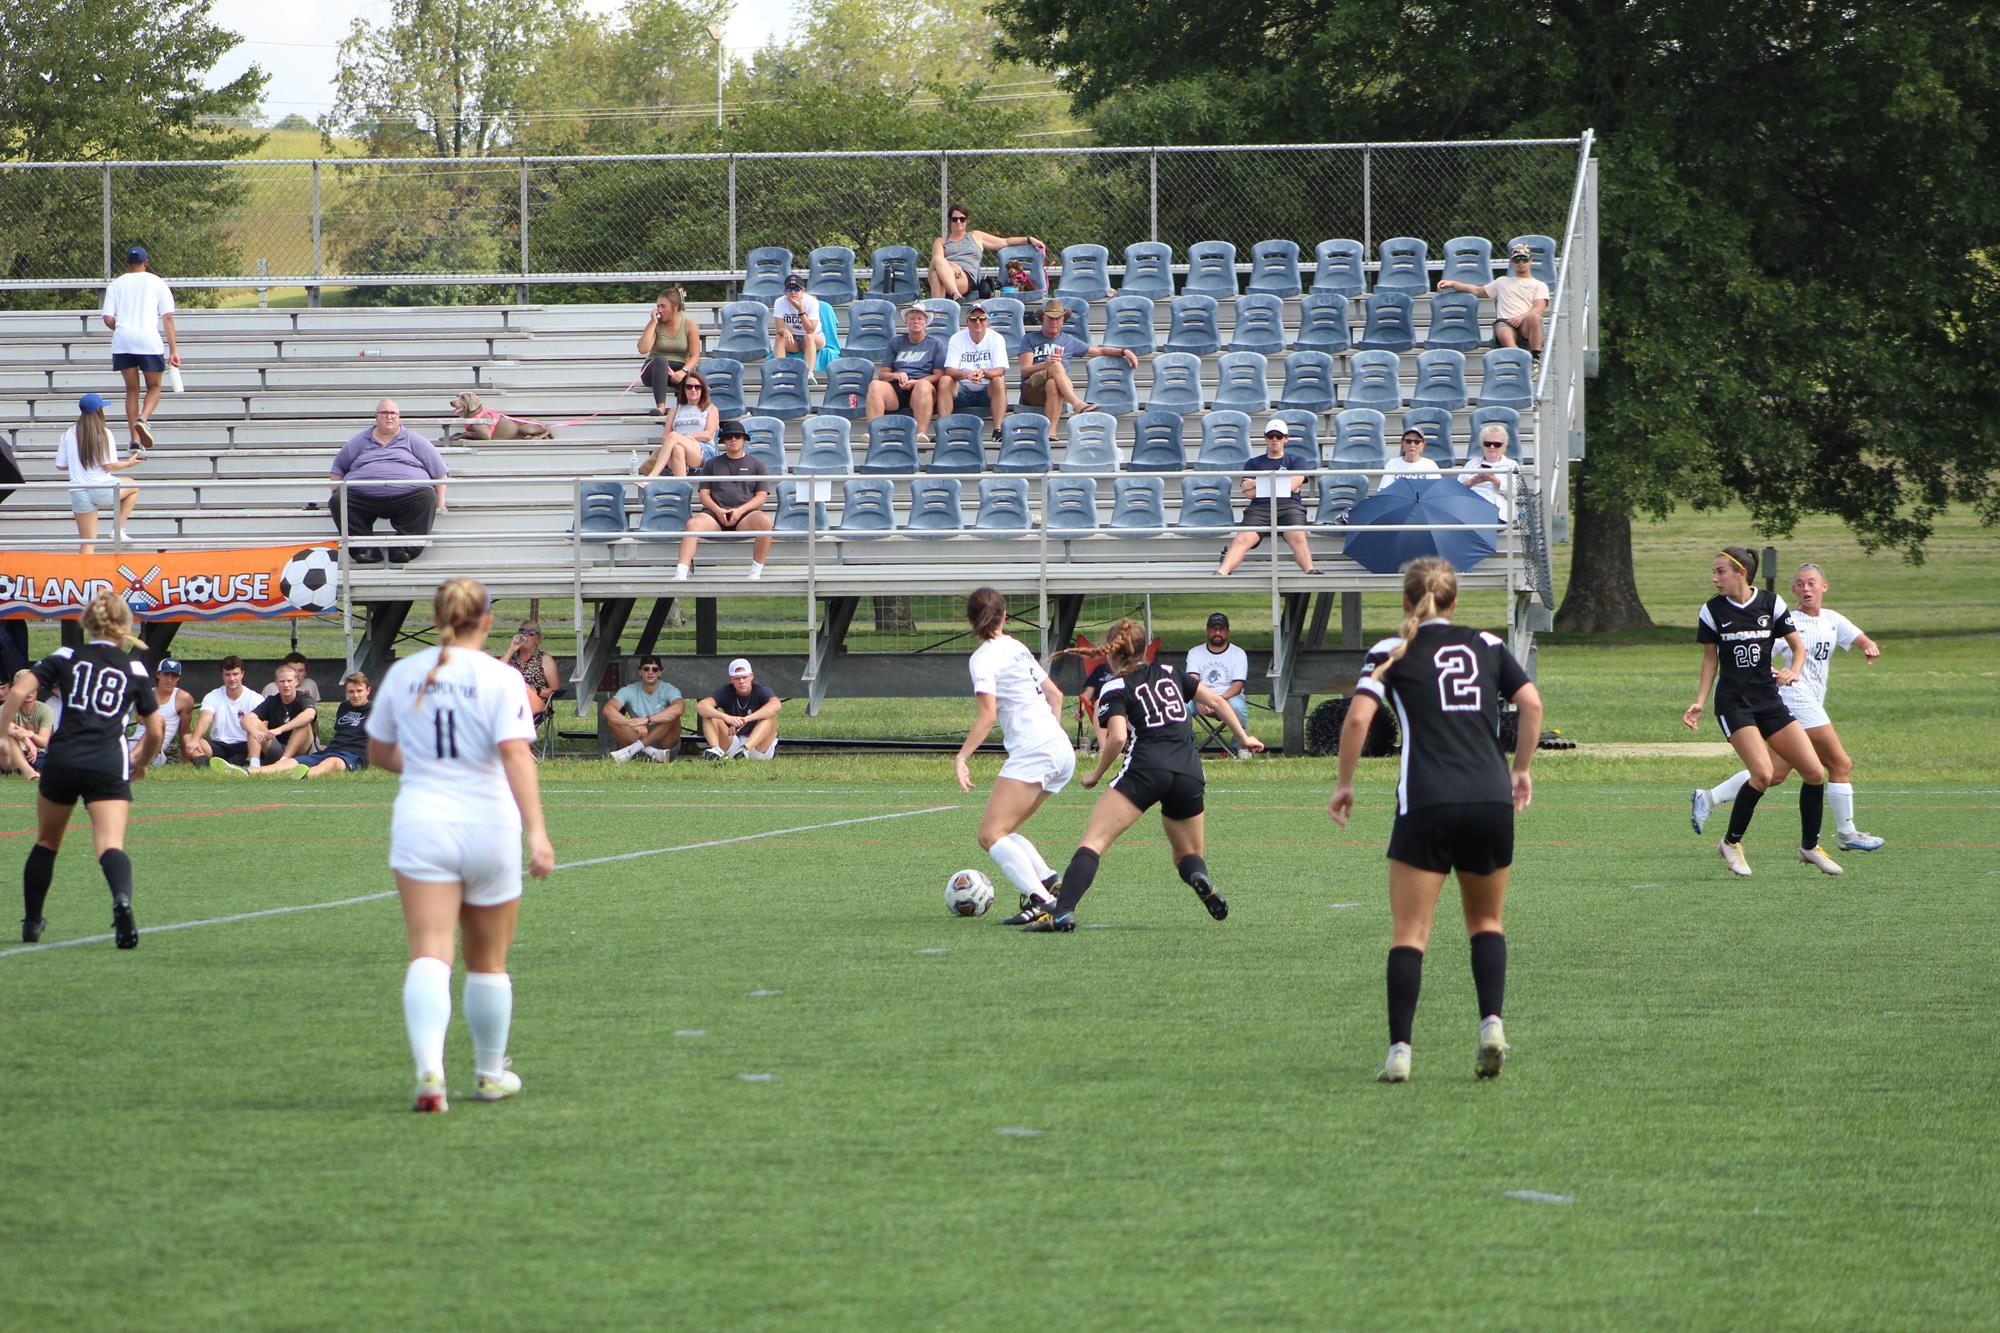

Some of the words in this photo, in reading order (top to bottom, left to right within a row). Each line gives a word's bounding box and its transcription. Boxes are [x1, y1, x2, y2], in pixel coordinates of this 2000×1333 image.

[161, 573, 270, 605] HOUSE
[1733, 643, 1761, 668] 26
[1814, 641, 1830, 661] 26
[68, 660, 127, 717] 18
[1433, 644, 1481, 711] 2
[1135, 678, 1188, 728] 19
[434, 708, 460, 758] 11
